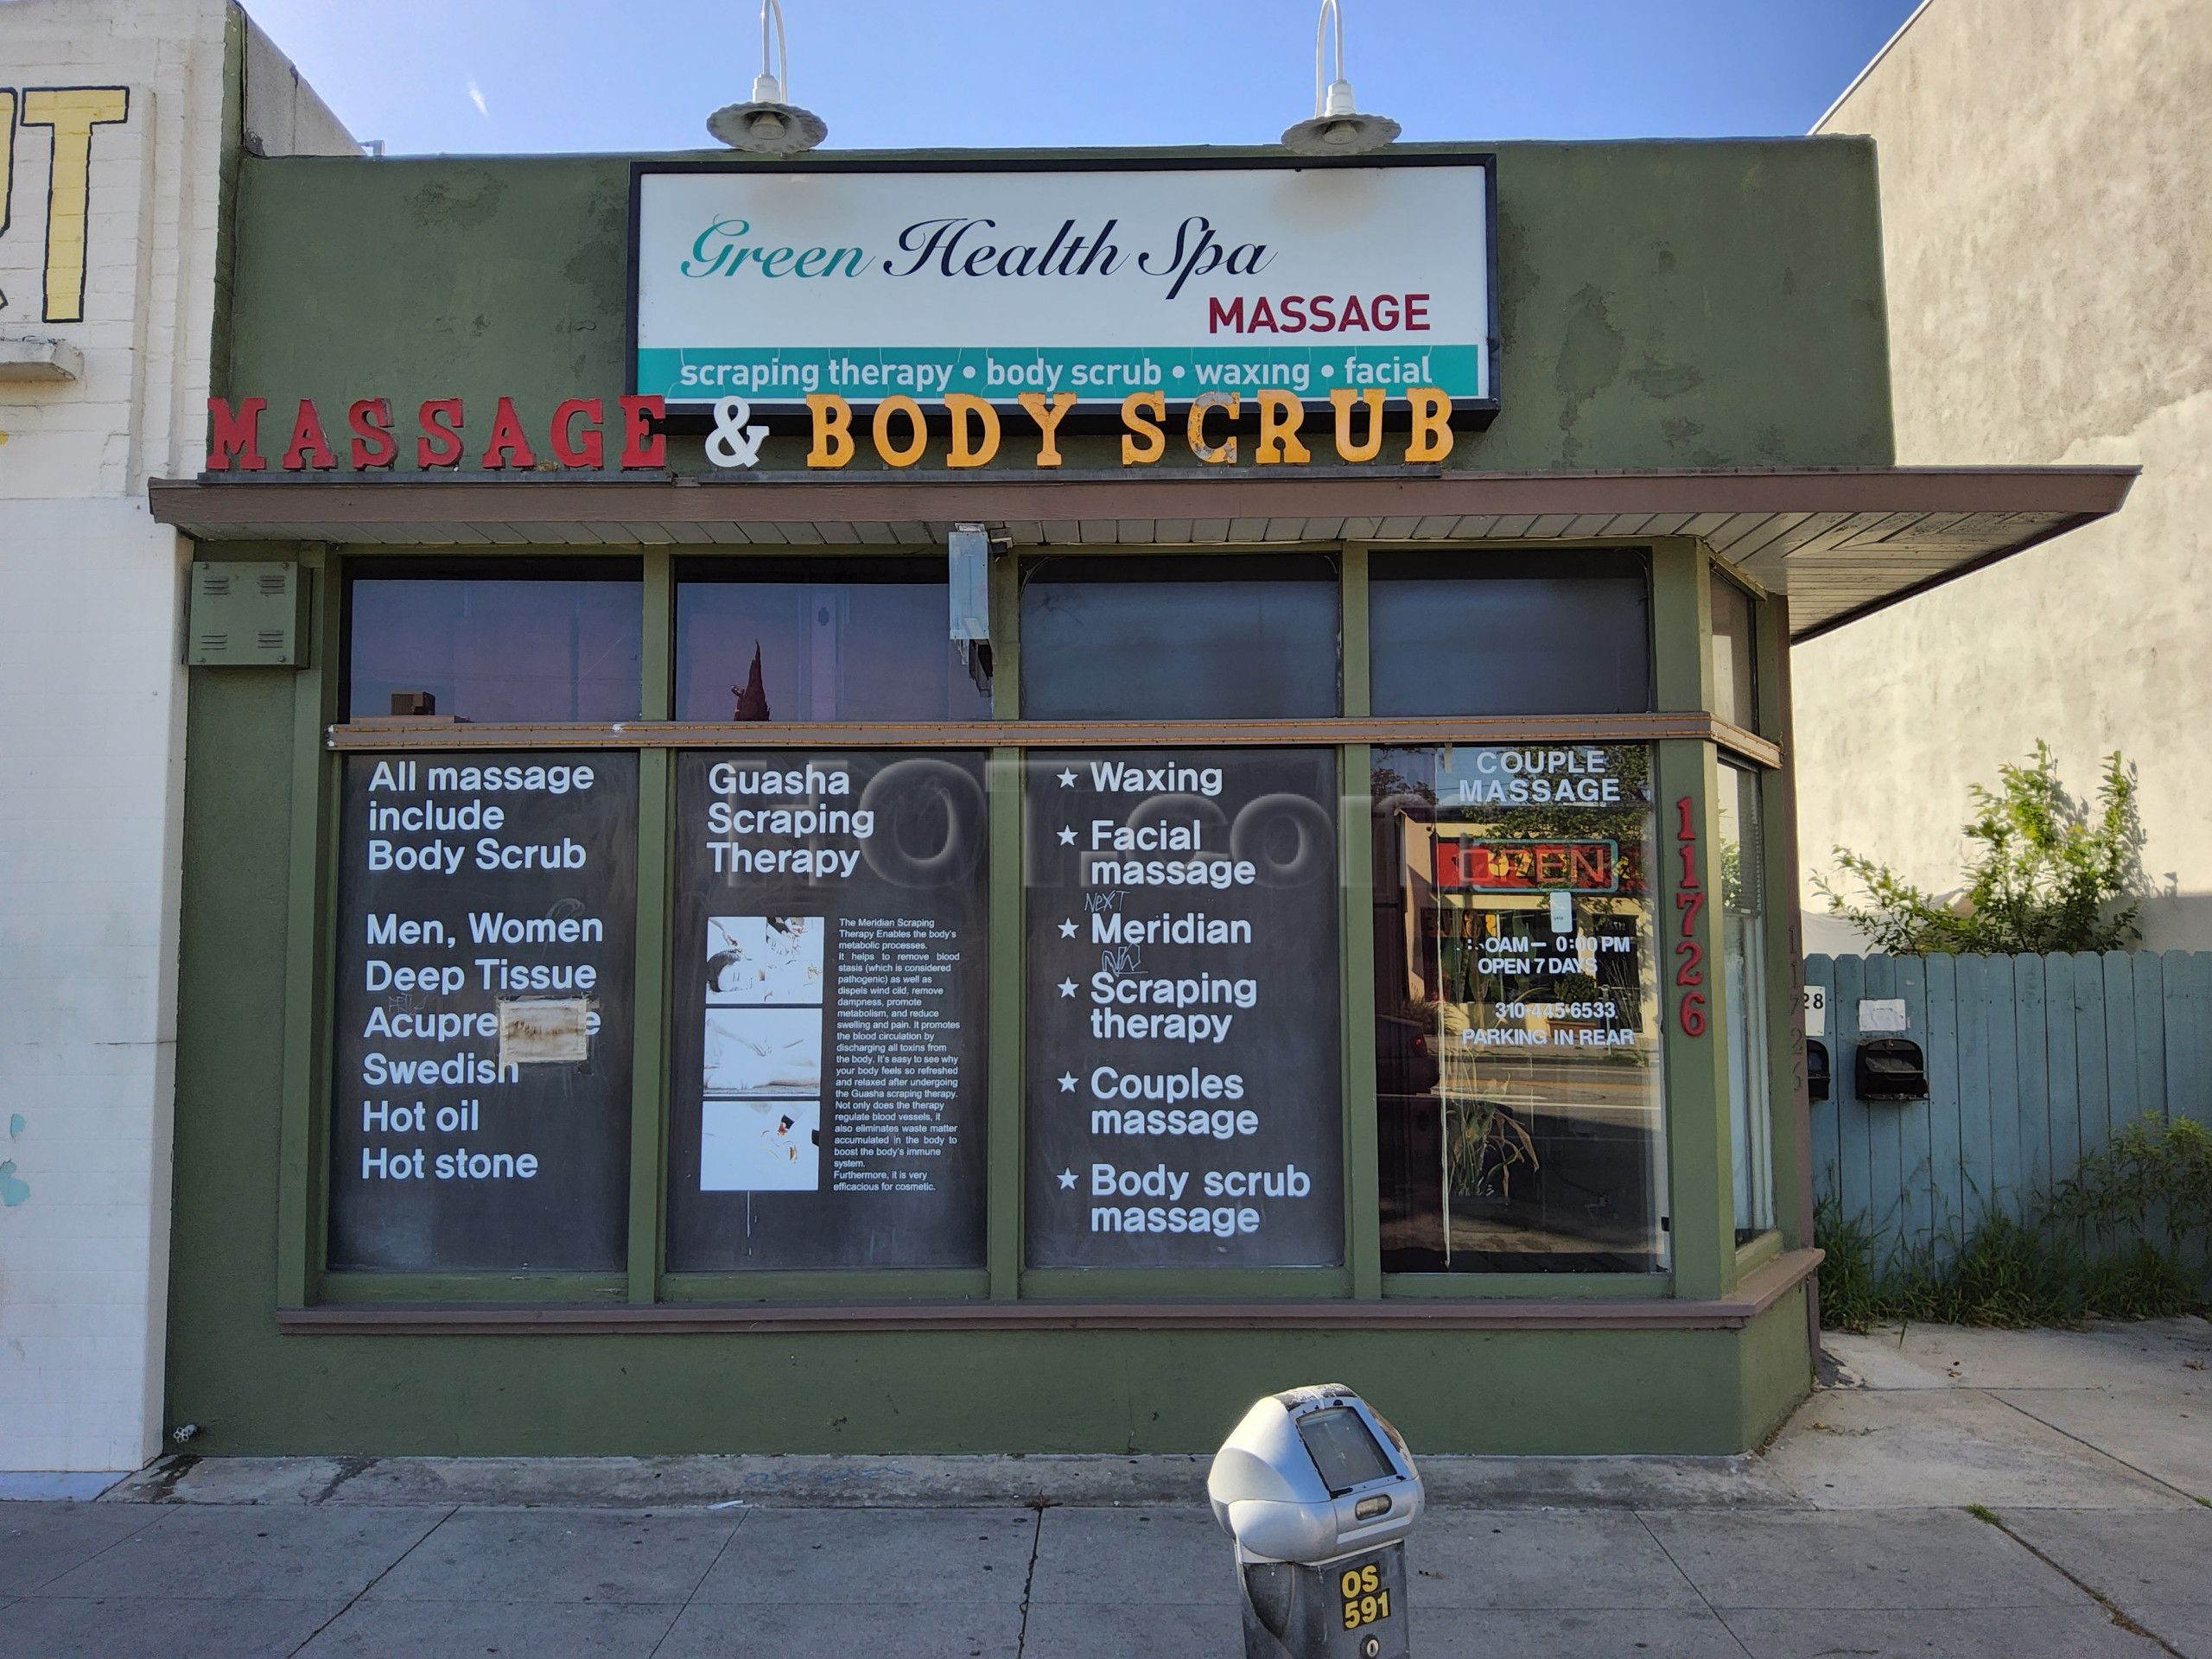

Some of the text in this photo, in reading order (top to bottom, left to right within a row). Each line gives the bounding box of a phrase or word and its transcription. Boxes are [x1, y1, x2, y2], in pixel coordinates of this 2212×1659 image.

[680, 213, 1277, 299] Green Health Spa
[1210, 294, 1430, 334] MASSAGE
[680, 355, 1432, 393] scraping therapy body scrub waxing facial
[207, 387, 1454, 471] MASSAGE & BODY SCRUB
[368, 760, 594, 794] All massage
[1477, 750, 1605, 774] COUPLE
[709, 763, 849, 795] Guasha
[1091, 761, 1223, 795] Waxing
[1459, 779, 1621, 803] MASSAGE
[369, 800, 505, 831] include
[707, 802, 874, 838] Scraping
[1092, 819, 1201, 850] Facial
[368, 838, 586, 874] Body Scrub
[706, 842, 860, 878] Therapy
[1092, 859, 1256, 889] massage
[367, 912, 603, 948] Men, Women
[897, 918, 935, 928] Scraping
[1092, 912, 1252, 944] Meridian
[1676, 797, 1706, 1037] 11726
[839, 930, 874, 939] Therapy
[839, 941, 927, 951] metabolic processes.
[1601, 936, 1630, 952] PM
[838, 963, 951, 974] stasis (which is considered
[851, 953, 874, 963] helps
[1478, 957, 1598, 975] OPEN 7 DAYS
[366, 959, 596, 995] Deep Tissue
[838, 976, 887, 985] pathogenic)
[838, 987, 868, 996] dispels
[1090, 972, 1257, 1007] Scraping
[837, 1009, 939, 1020] metabolism, and reduce
[838, 998, 922, 1008] dampness, promote
[1496, 1002, 1616, 1019] 310-445-6533
[364, 1007, 601, 1041] Acupree
[837, 1020, 960, 1031] swelling and pain. It promotes
[837, 1032, 935, 1042] the blood circulation by
[1090, 1007, 1232, 1043] therapy
[1463, 1029, 1635, 1045] PARKING IN REAR
[836, 1044, 886, 1053] discharging
[836, 1055, 849, 1064] the
[852, 1055, 874, 1065] body.
[892, 1056, 912, 1065] easy
[914, 1055, 922, 1064] to
[941, 1055, 958, 1065] why
[363, 1052, 518, 1086] Swedish
[836, 1068, 854, 1077] your
[858, 1066, 879, 1077] body
[881, 1066, 902, 1075] feels
[918, 1066, 958, 1075] refreshed
[911, 1078, 958, 1088] undergoing
[887, 1090, 922, 1099] scraping
[925, 1090, 958, 1099] therapy.
[1091, 1066, 1244, 1103] Couples
[363, 1099, 479, 1132] Hot oil
[835, 1113, 870, 1122] regulate
[899, 1113, 932, 1122] vessels,
[836, 1101, 944, 1111] Not only does the therapy
[1091, 1108, 1258, 1140] massage
[834, 1147, 858, 1156] boost
[861, 1147, 874, 1156] the
[907, 1147, 941, 1156] immune
[924, 1136, 944, 1146] body
[362, 1148, 538, 1179] Hot stone
[834, 1160, 865, 1169] system.
[834, 1171, 927, 1181] Furthermore, it is very
[1092, 1164, 1311, 1200] Body scrub
[1091, 1205, 1260, 1237] massage
[1342, 1565, 1379, 1599] OS
[1344, 1592, 1389, 1629] 591
